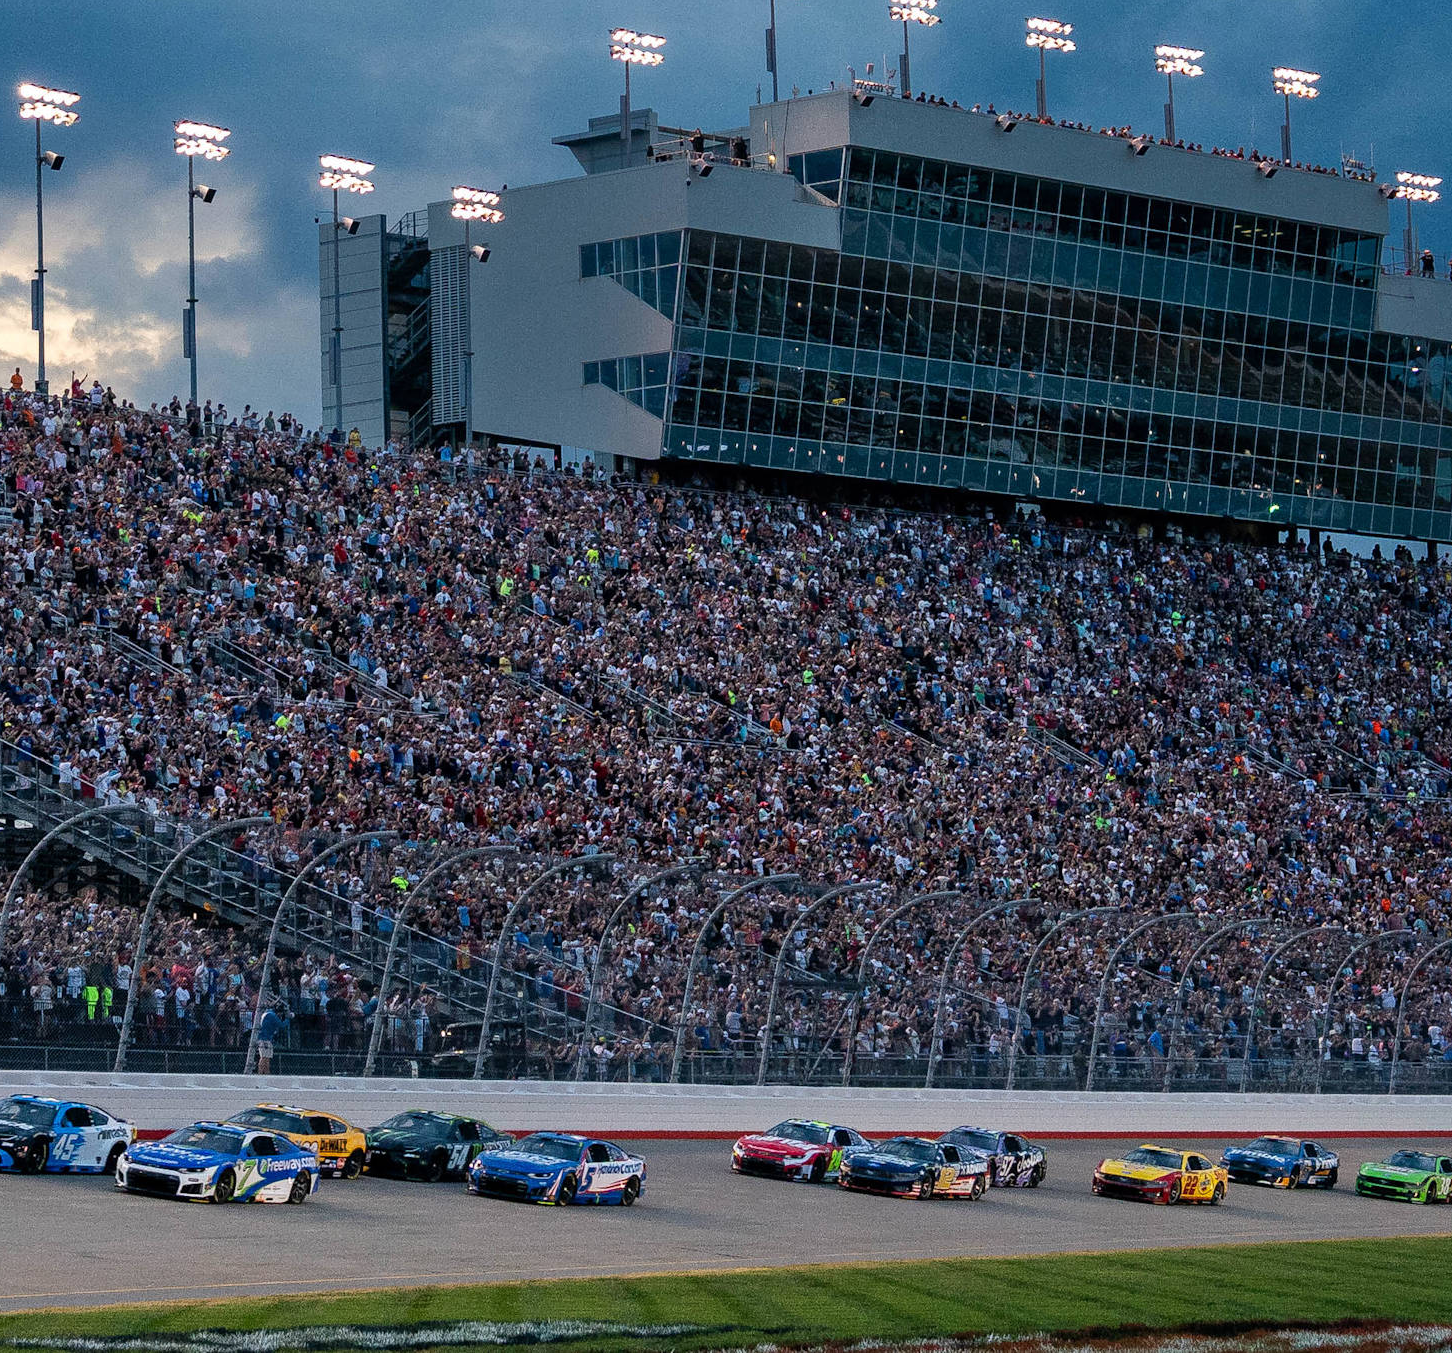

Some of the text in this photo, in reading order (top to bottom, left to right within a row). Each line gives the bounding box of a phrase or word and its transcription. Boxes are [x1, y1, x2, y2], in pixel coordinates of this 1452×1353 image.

[52, 1133, 79, 1161] 45
[447, 1144, 471, 1169] 54
[238, 1158, 258, 1190] 7
[267, 1156, 316, 1172] Freeway.com
[577, 1166, 598, 1192] 5
[1183, 1175, 1199, 1196] 22
